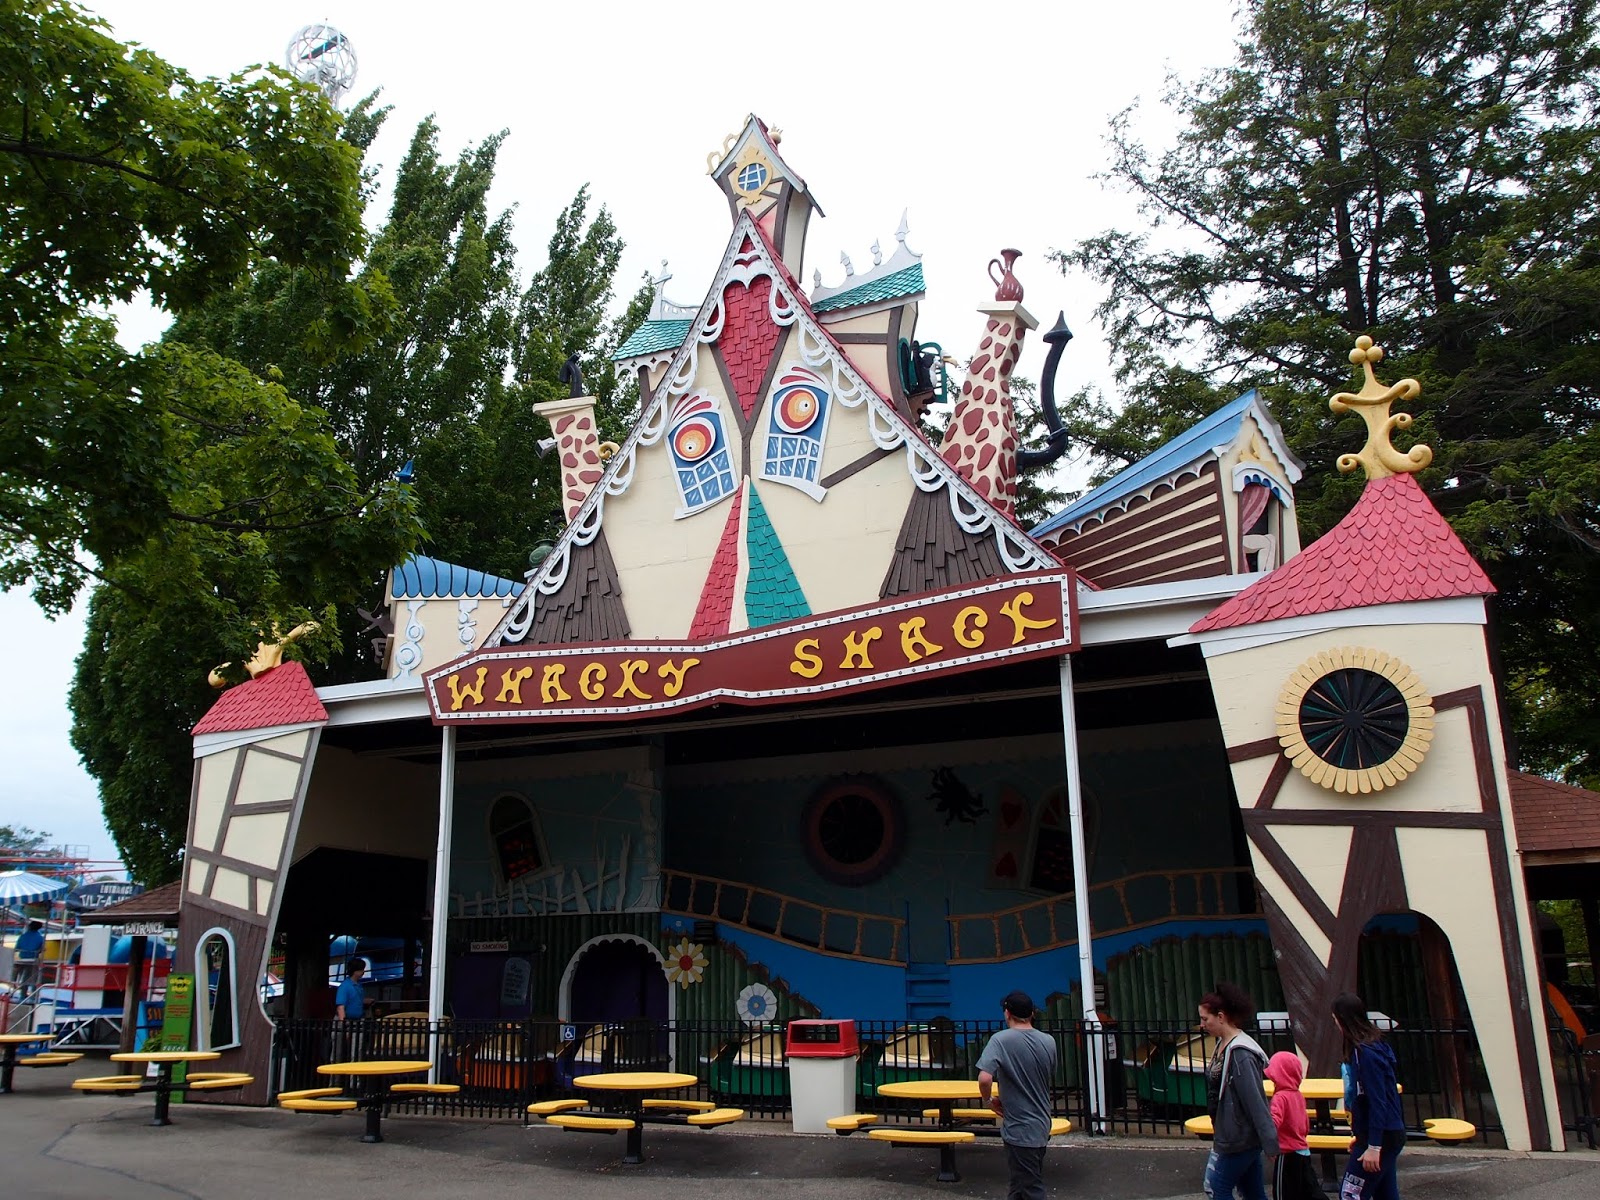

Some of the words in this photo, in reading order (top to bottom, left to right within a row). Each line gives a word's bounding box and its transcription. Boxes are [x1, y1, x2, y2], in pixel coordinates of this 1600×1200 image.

[447, 658, 700, 711] WHACKY
[790, 591, 1057, 678] SHACK
[100, 885, 133, 894] ENTRANCE
[125, 922, 163, 935] ENTRANCE
